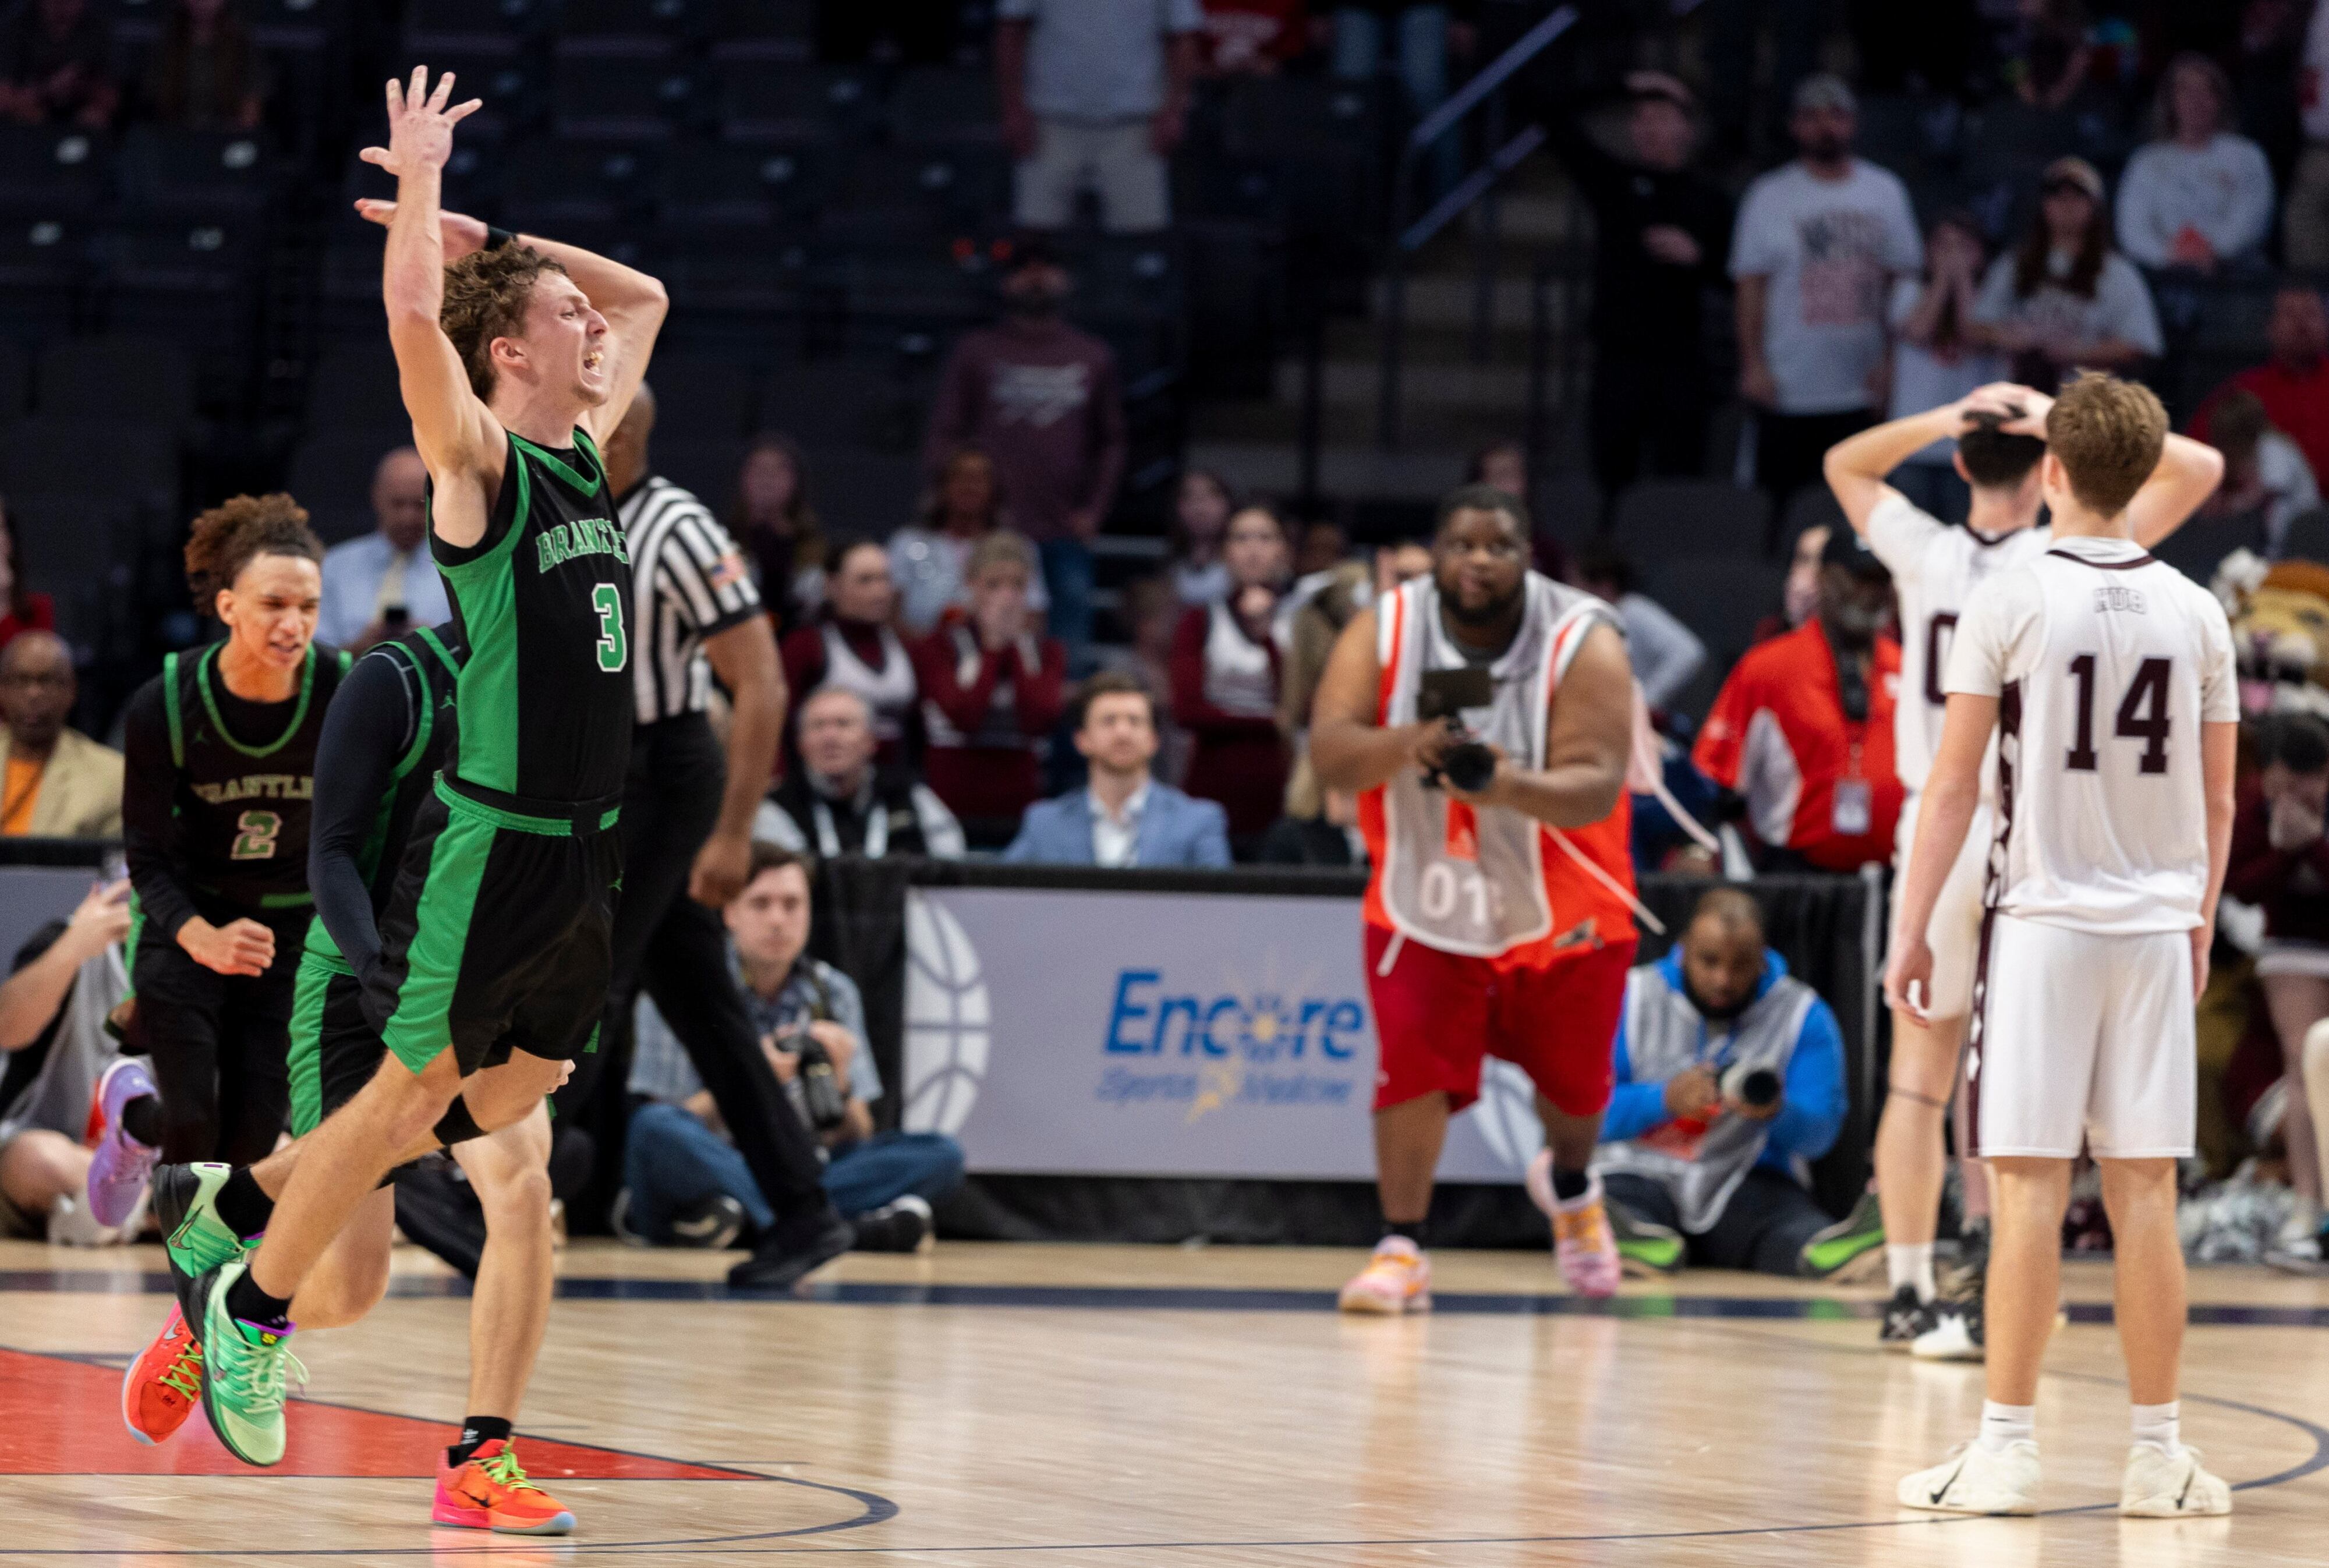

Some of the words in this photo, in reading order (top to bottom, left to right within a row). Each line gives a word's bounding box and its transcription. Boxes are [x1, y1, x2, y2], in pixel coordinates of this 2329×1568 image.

[592, 583, 627, 672] 3
[2067, 653, 2172, 774] 14
[231, 810, 282, 860] 2
[1104, 968, 1364, 1062] Encore
